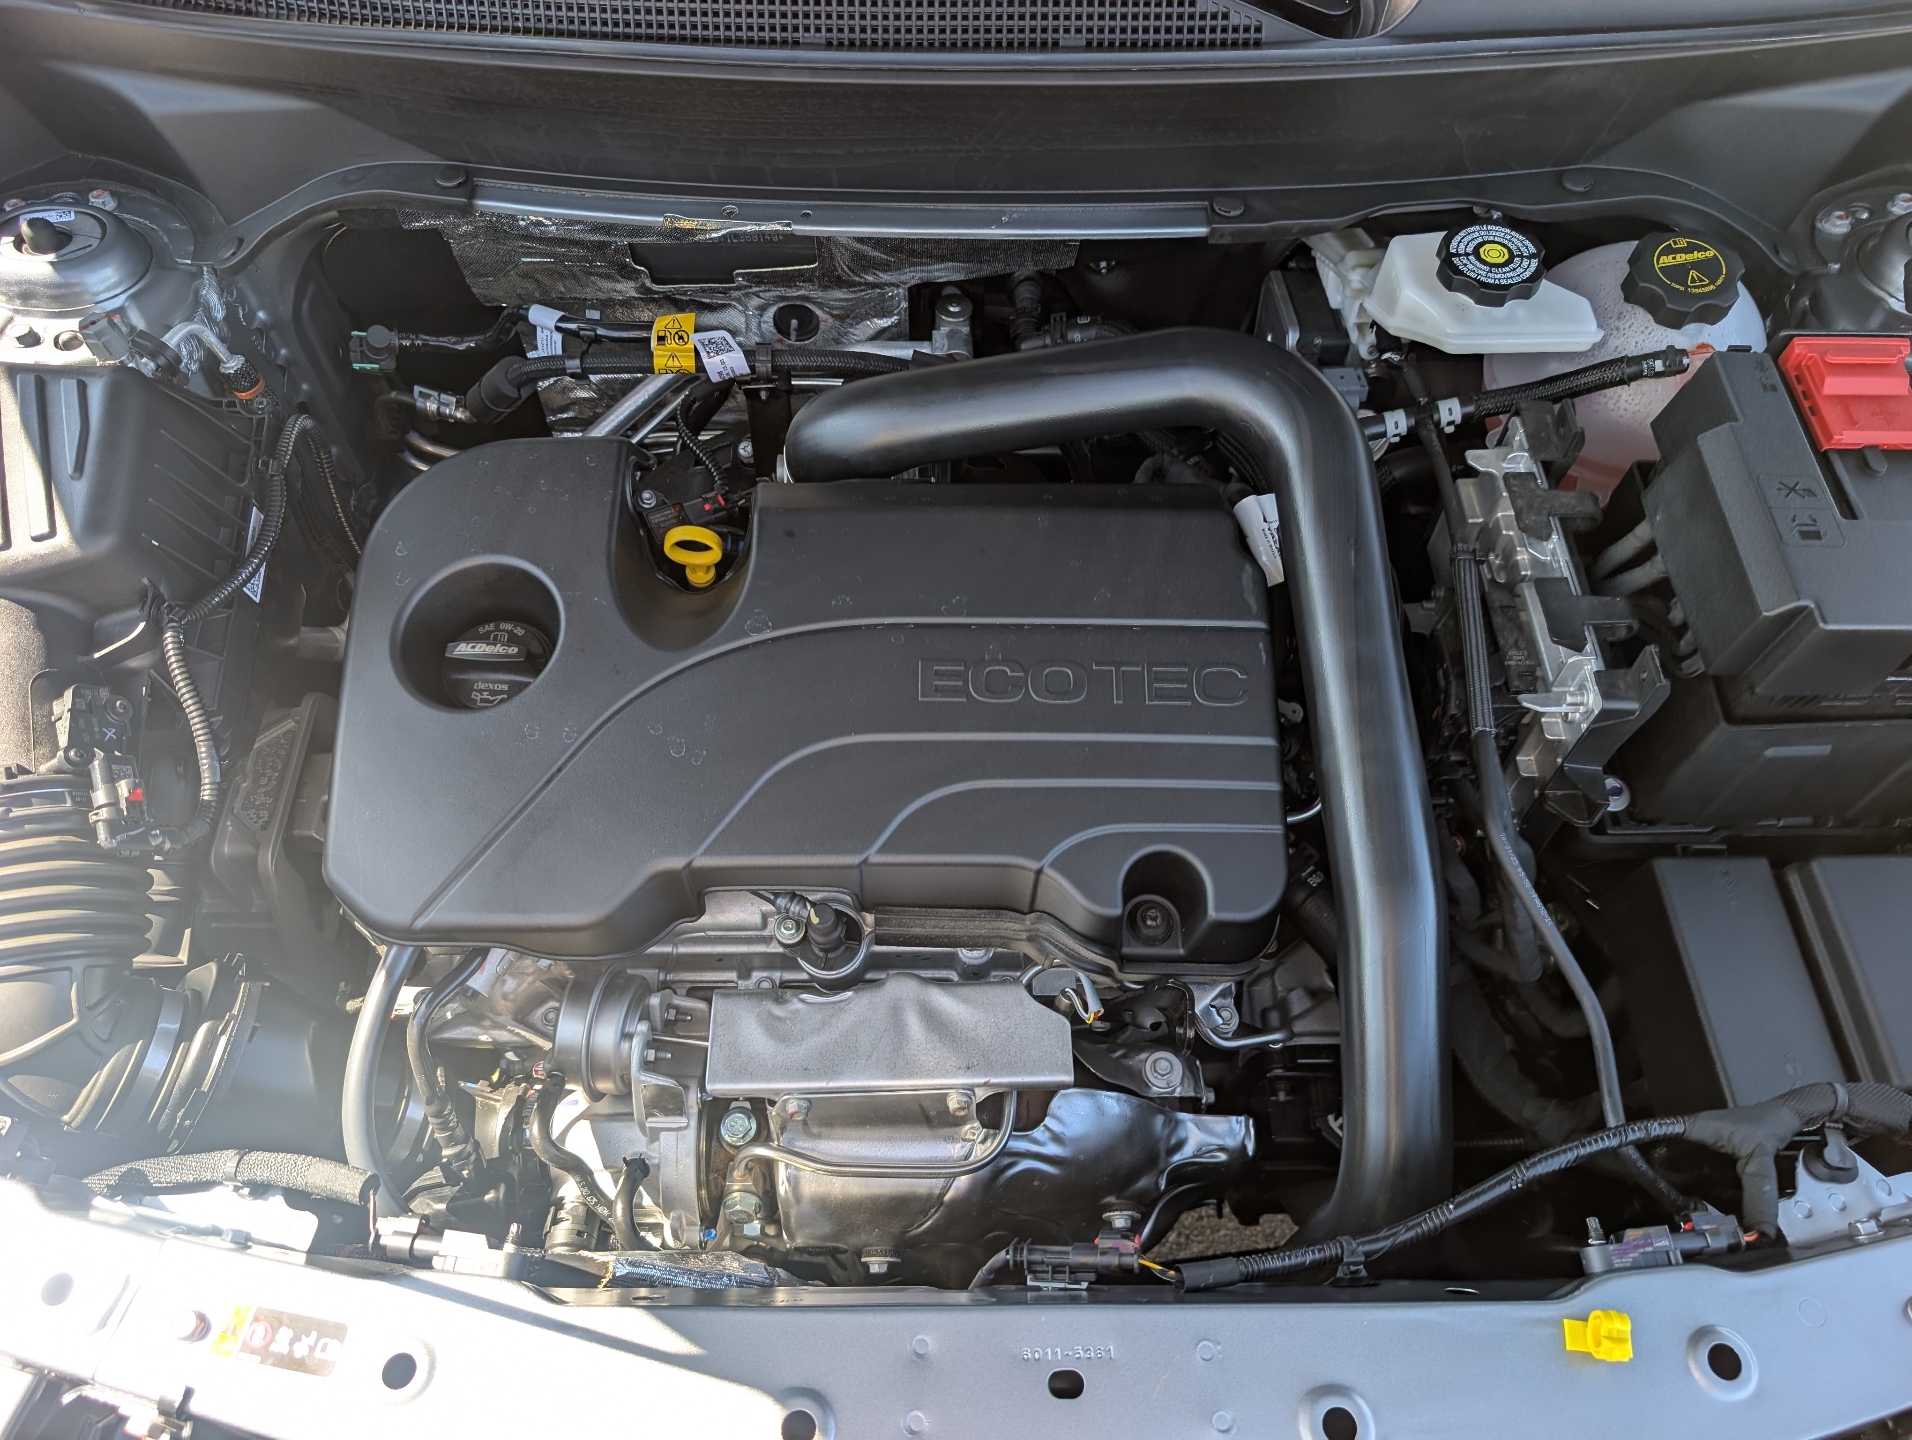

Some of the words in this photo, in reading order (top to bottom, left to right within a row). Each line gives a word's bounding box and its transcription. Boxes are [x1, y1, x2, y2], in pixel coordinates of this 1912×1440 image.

[1658, 251, 1715, 264] ACDelco
[1462, 267, 1477, 278] FLUID
[1477, 276, 1494, 284] FROM
[1500, 276, 1521, 285] SEALED
[478, 623, 495, 634] SAE
[500, 622, 525, 636] 0W-20
[454, 643, 519, 655] ACDelco
[474, 682, 509, 690] dexos
[918, 659, 1249, 706] ECOTEC
